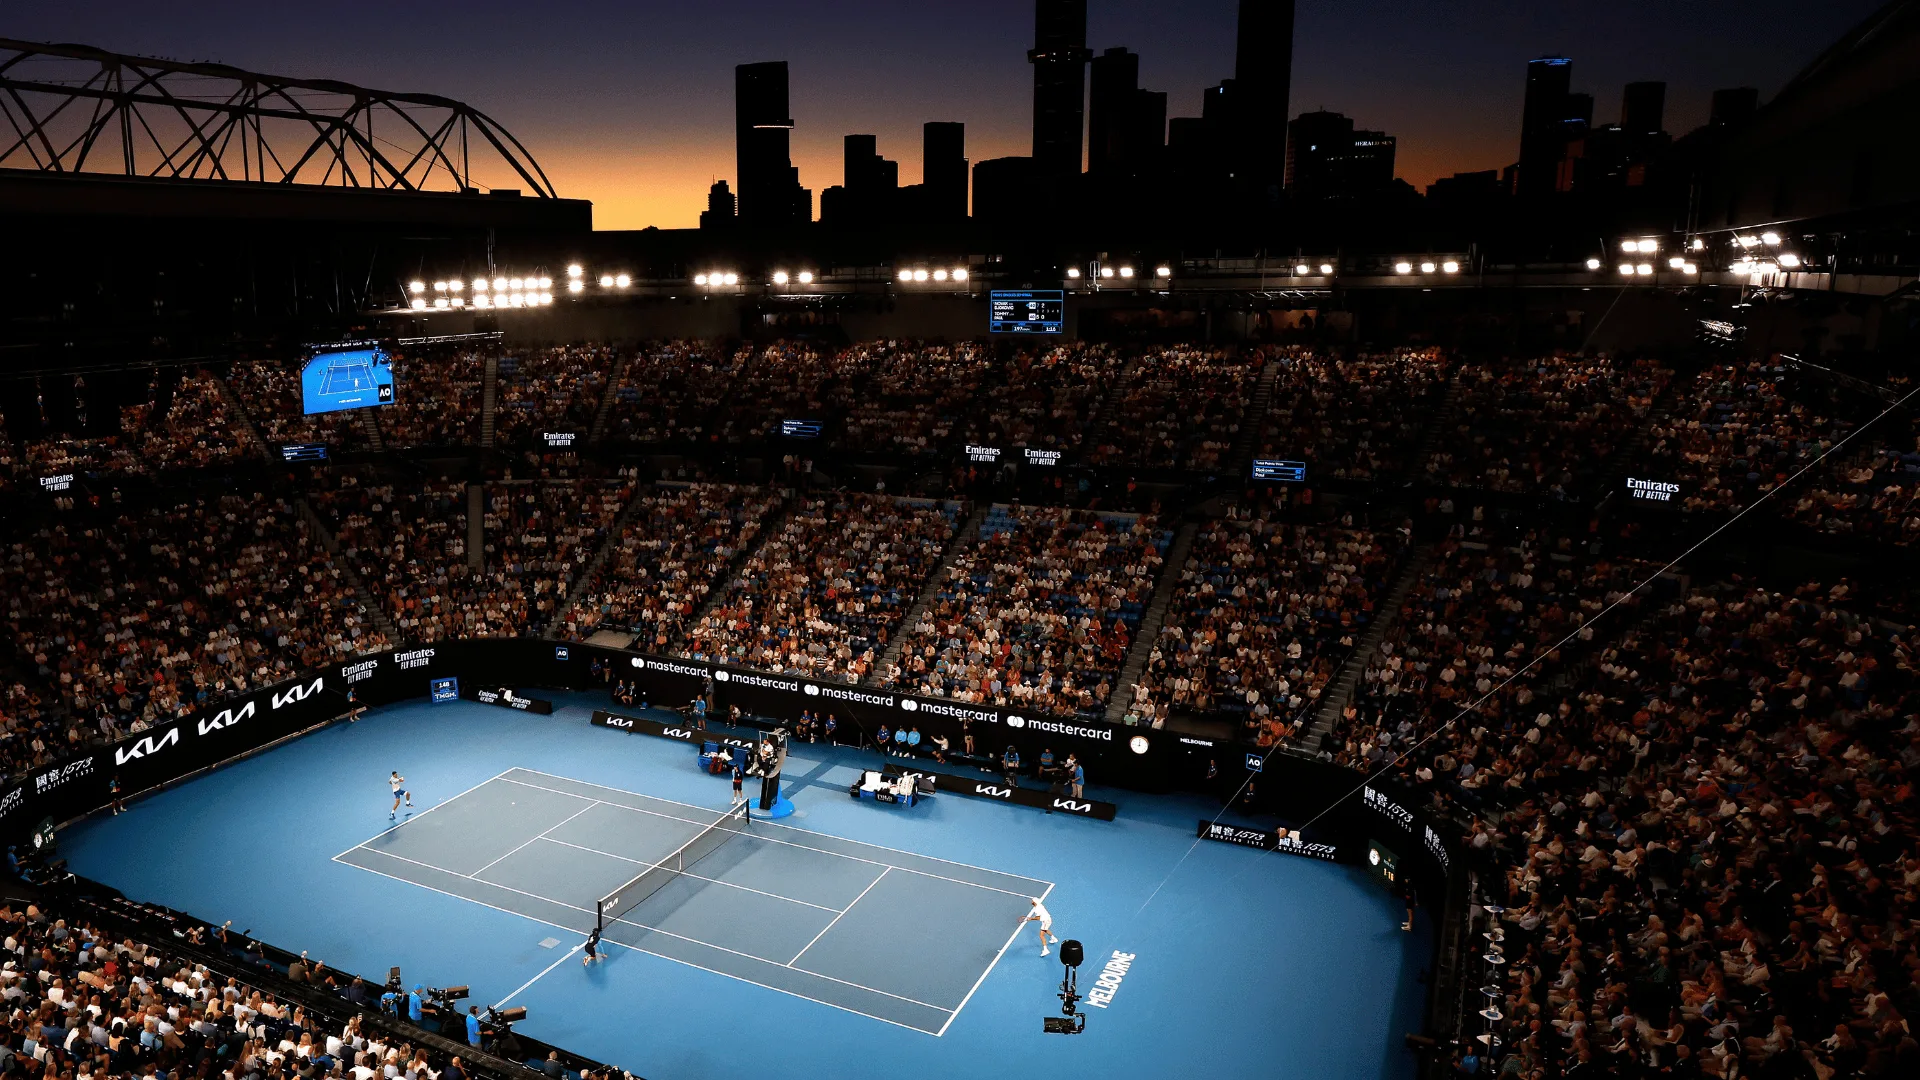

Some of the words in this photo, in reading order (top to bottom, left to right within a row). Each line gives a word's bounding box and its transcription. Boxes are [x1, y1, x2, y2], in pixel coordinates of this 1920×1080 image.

[380, 388, 390, 396] AO
[966, 446, 1000, 455] Emirates
[1025, 449, 1060, 458] Emirates
[40, 474, 74, 485] Emirates
[54, 482, 69, 490] BETTER
[1627, 478, 1680, 492] Emirates
[1633, 489, 1645, 498] FLY
[1646, 491, 1671, 501] BETTER
[394, 648, 435, 662] Emirates
[342, 660, 378, 677] Emirates
[410, 657, 429, 668] BETTER
[647, 659, 708, 677] mastercard
[355, 670, 372, 681] BETTER
[732, 673, 798, 692] mastercard
[272, 677, 323, 710] KIA
[822, 687, 894, 706] mastercard
[198, 701, 255, 736] KIA
[921, 702, 998, 722] mastercard
[606, 716, 633, 728] KIA
[663, 727, 691, 739] KIA
[1028, 718, 1112, 741] mastercard
[115, 727, 179, 765] KIA
[1180, 738, 1213, 747] MELBOURNE
[1248, 758, 1260, 766] AO
[975, 784, 1011, 798] KIA
[1054, 798, 1091, 813] KIA
[602, 897, 618, 912] KIA
[1084, 950, 1136, 1009] MELBOURNE
